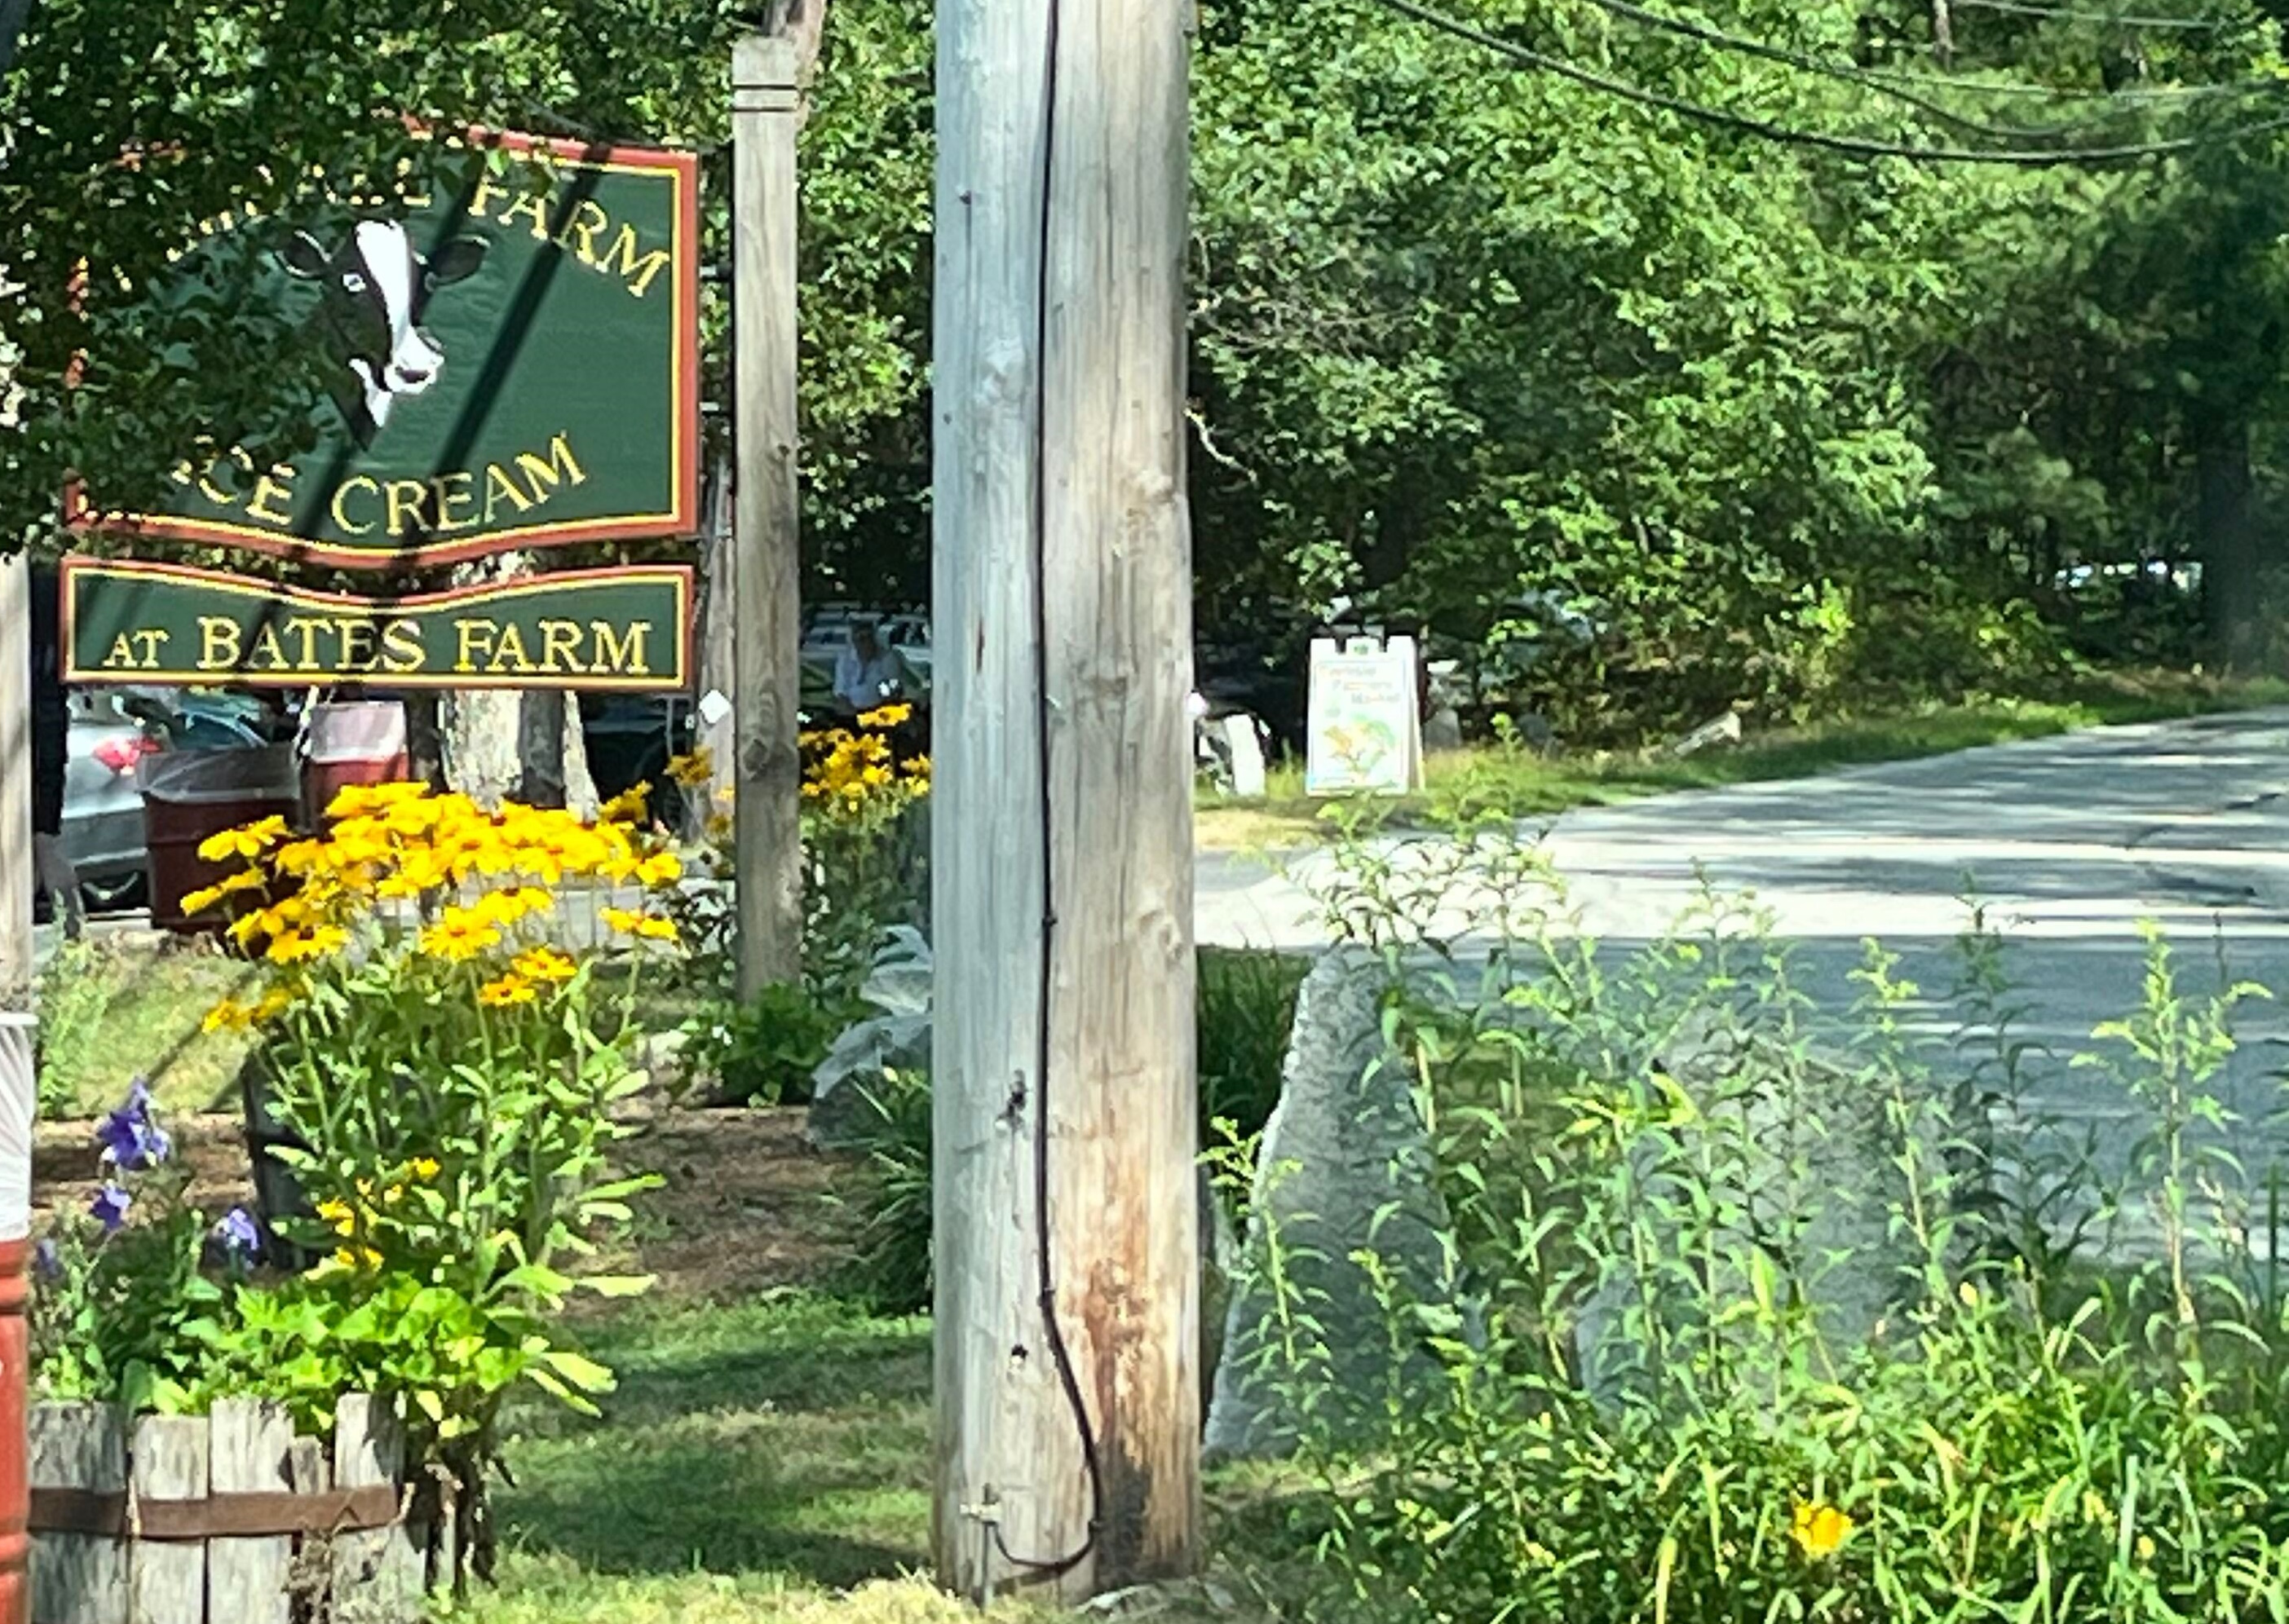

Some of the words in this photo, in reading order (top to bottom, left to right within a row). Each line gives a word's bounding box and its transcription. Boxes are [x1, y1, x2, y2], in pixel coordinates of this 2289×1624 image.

[467, 167, 669, 298] FARM
[331, 430, 586, 535] CREAM
[103, 629, 170, 667] AT
[196, 616, 426, 671] BATES
[453, 620, 652, 673] FARM
